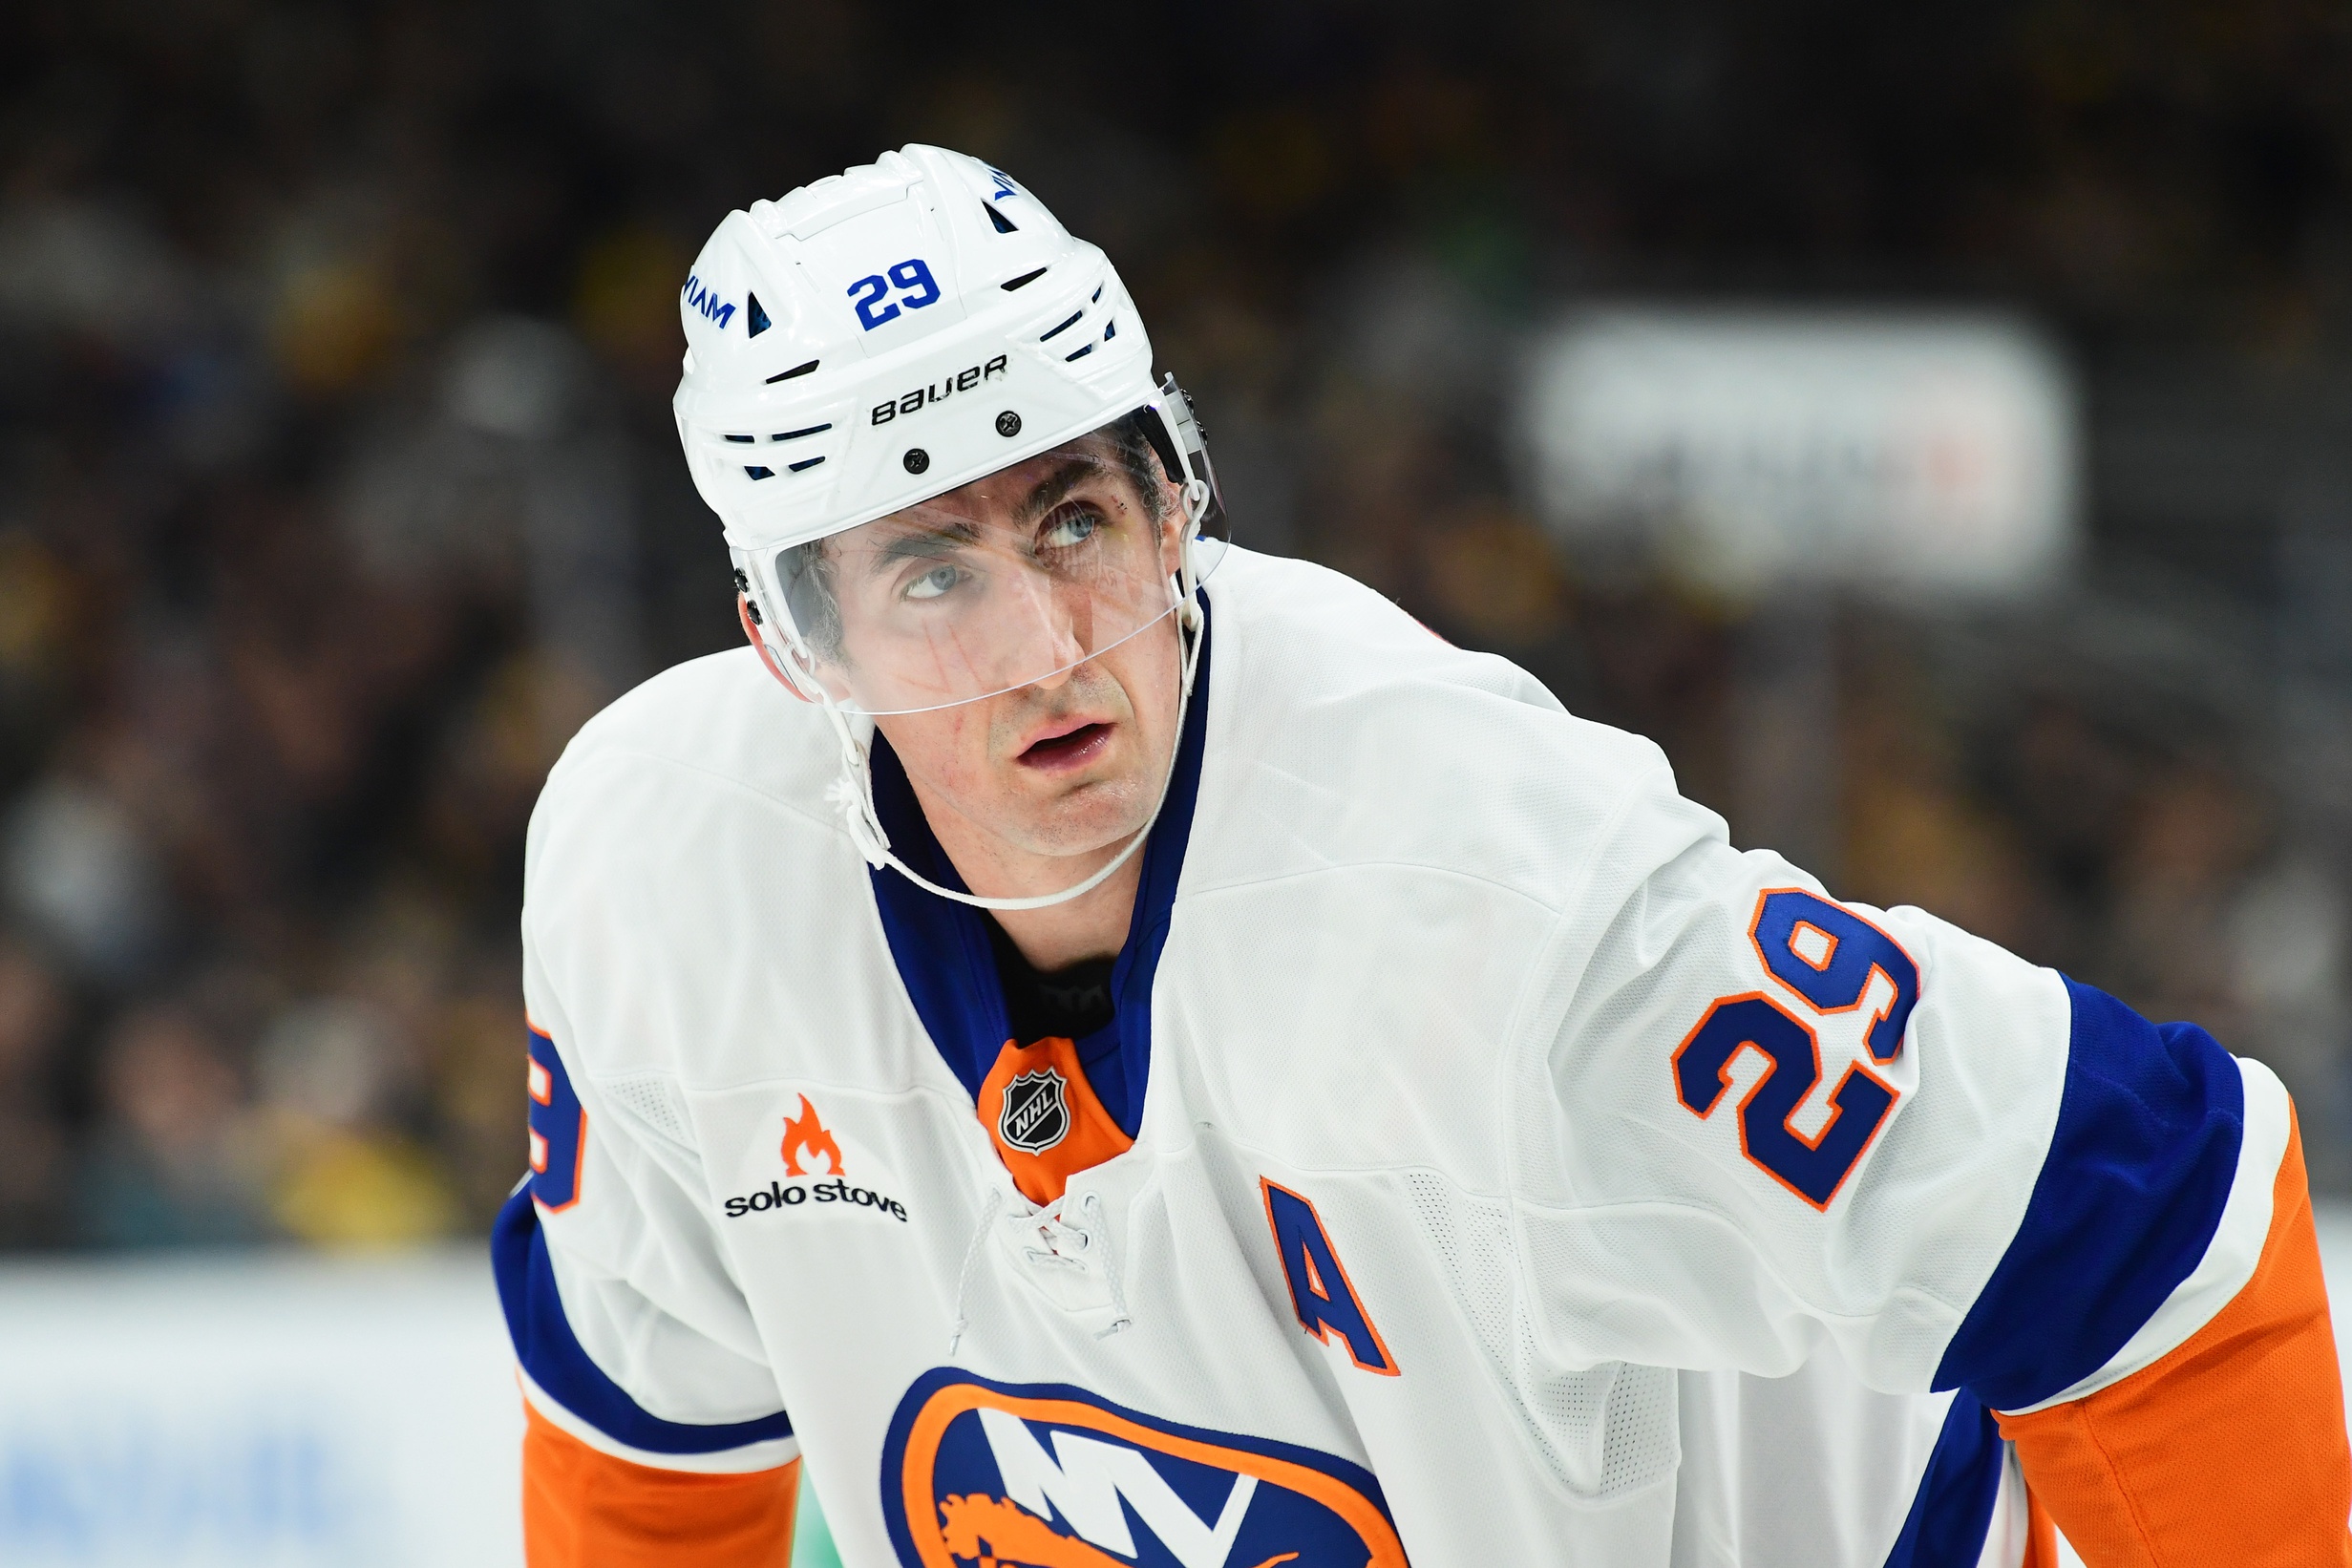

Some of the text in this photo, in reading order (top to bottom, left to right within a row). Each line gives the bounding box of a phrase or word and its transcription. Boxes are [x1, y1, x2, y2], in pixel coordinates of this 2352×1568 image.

[847, 259, 942, 331] 29
[1670, 887, 1920, 1213] 29
[1014, 1087, 1054, 1137] NHL
[725, 1178, 907, 1222] solo stove
[1260, 1175, 1401, 1376] A
